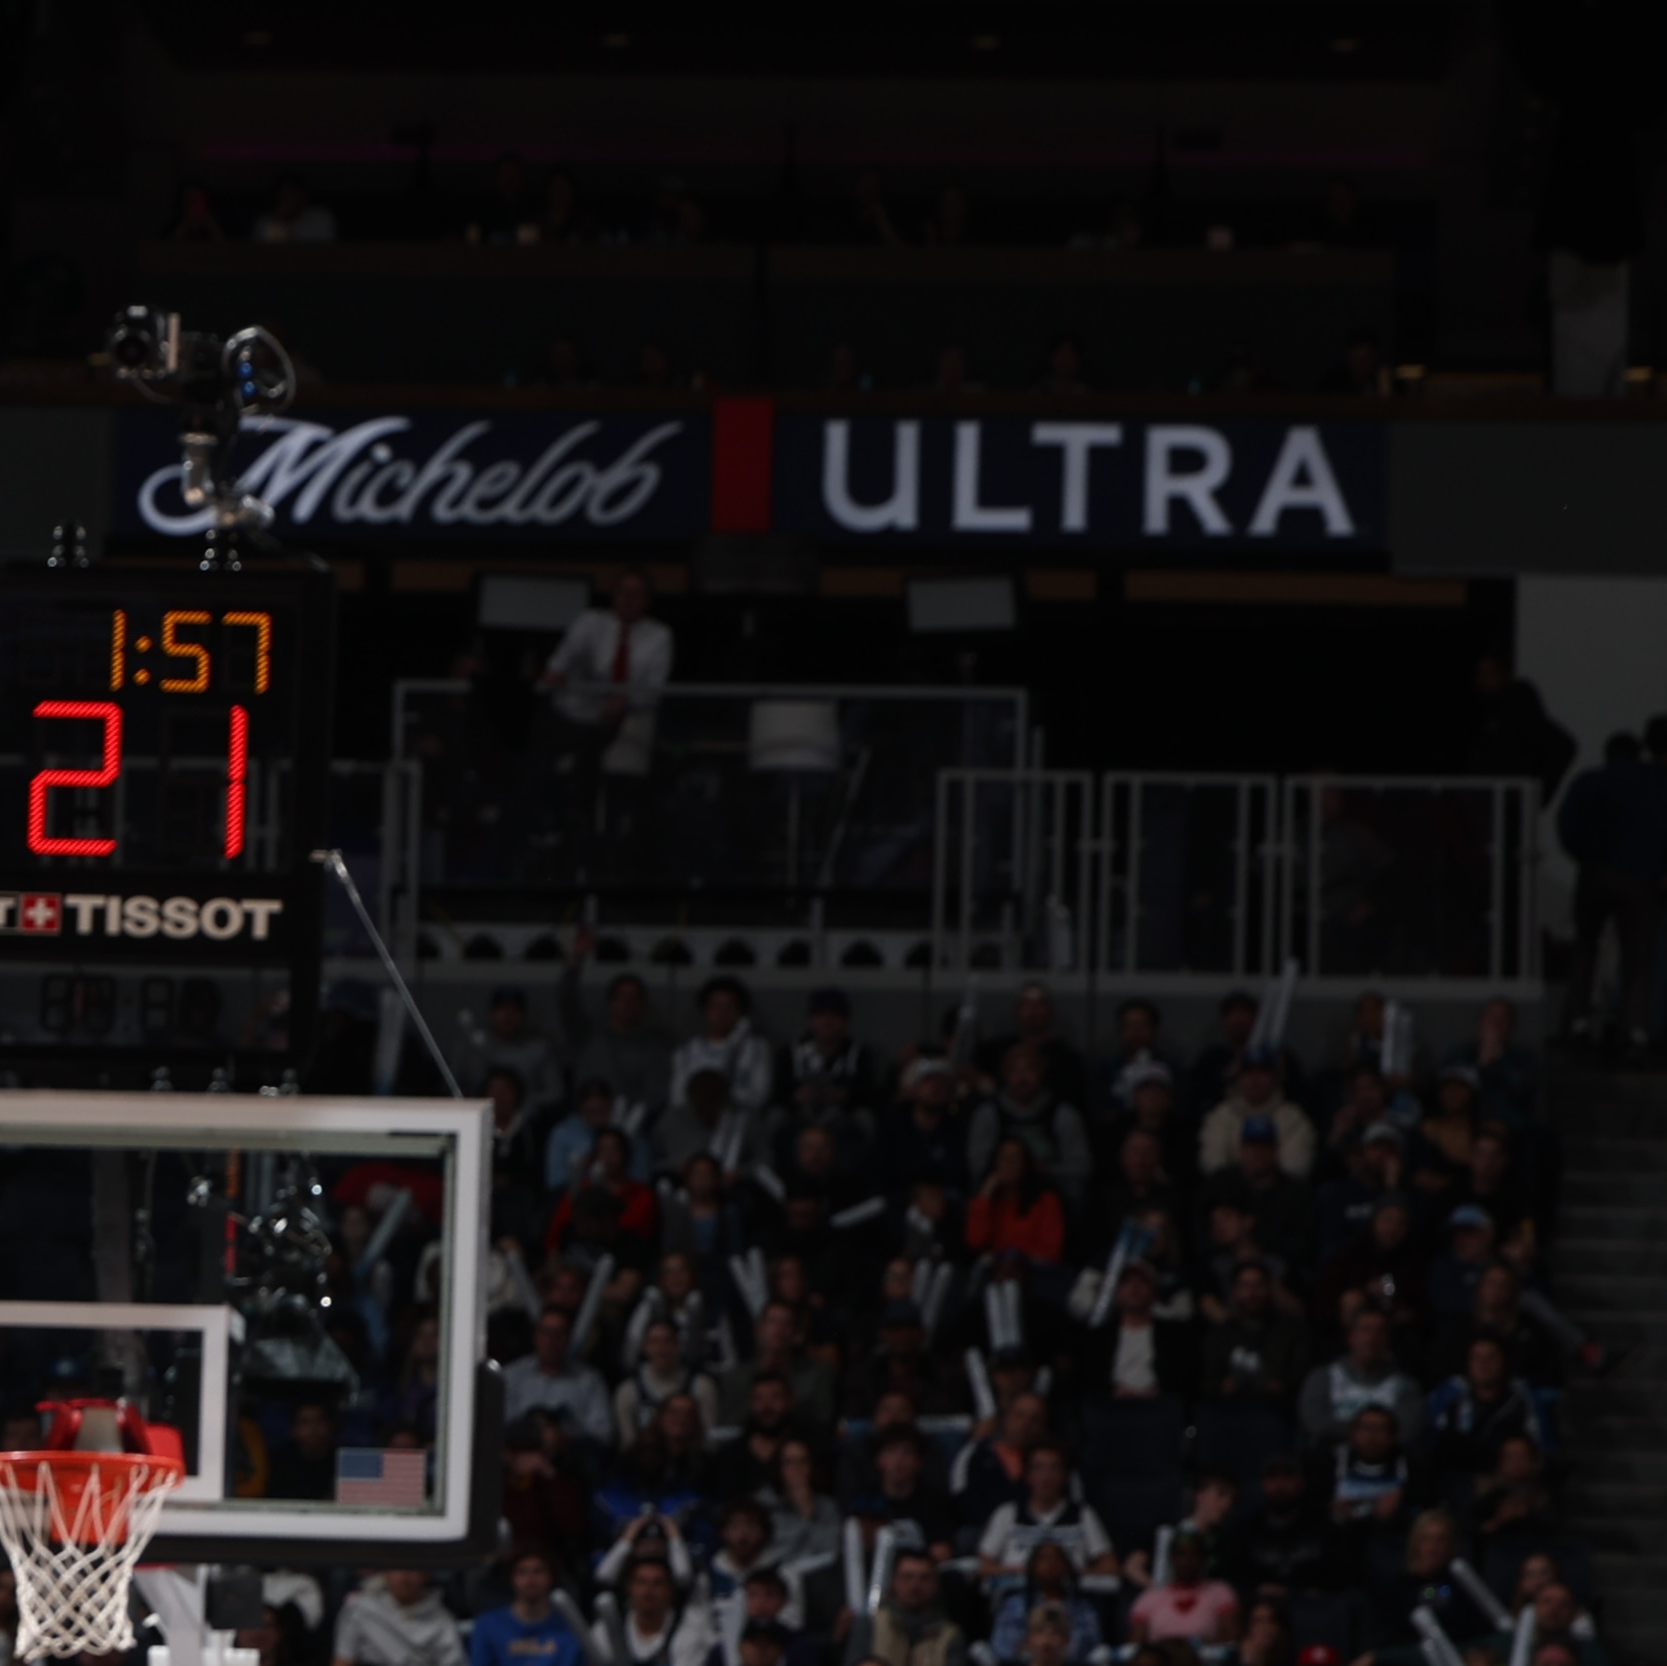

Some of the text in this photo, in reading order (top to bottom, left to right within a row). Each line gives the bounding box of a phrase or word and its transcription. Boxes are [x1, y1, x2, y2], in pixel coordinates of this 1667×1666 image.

[138, 415, 1357, 538] Michelob ULTRA
[110, 608, 273, 695] 1:57
[27, 699, 250, 861] 21
[65, 893, 283, 942] TISSOT
